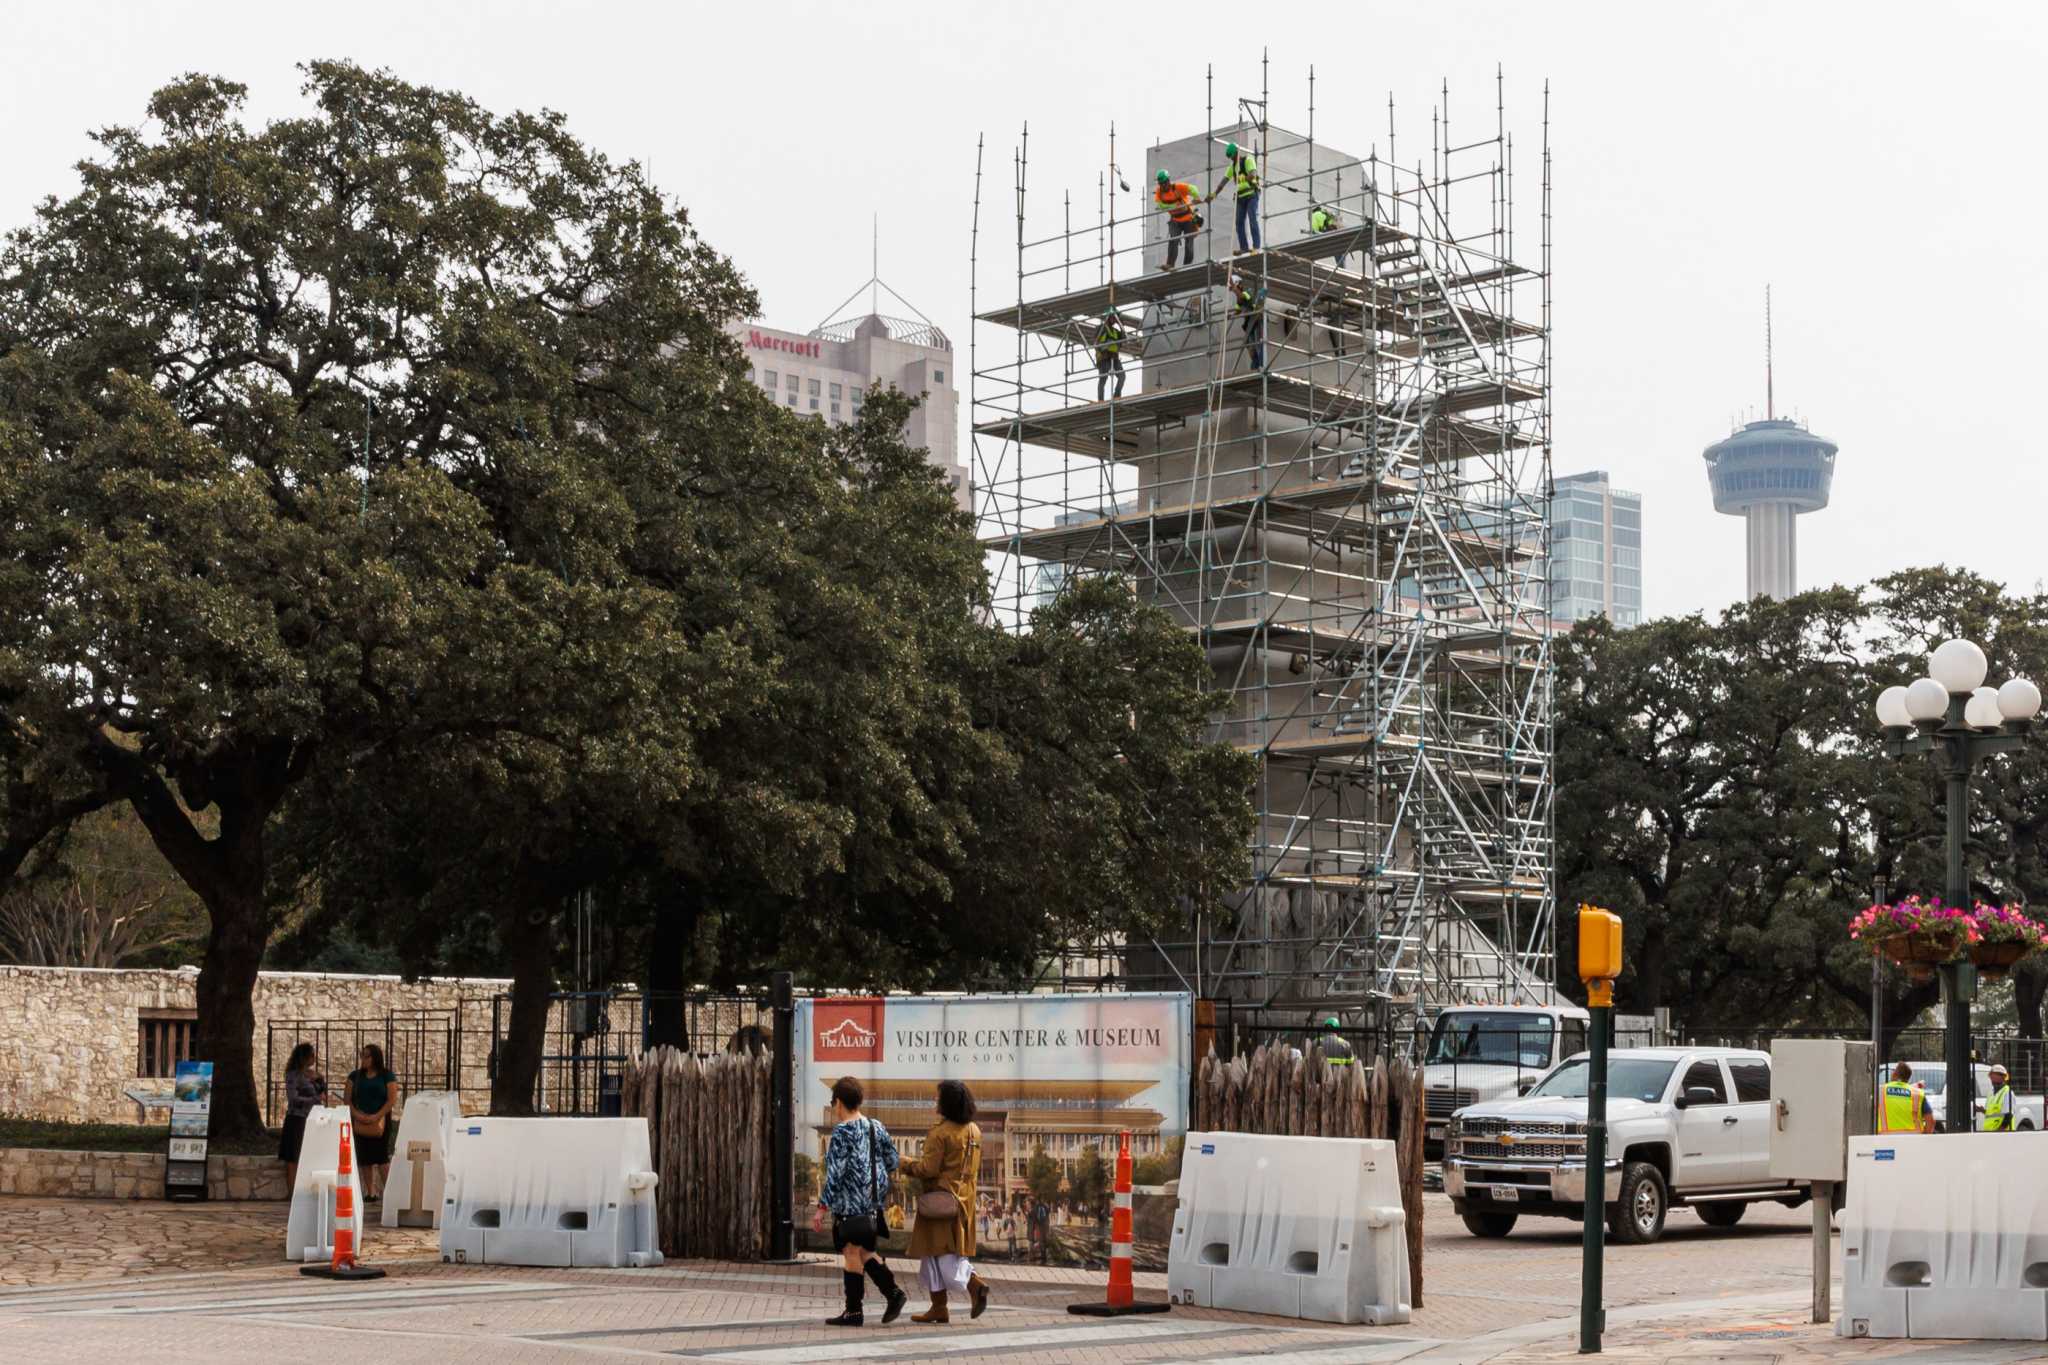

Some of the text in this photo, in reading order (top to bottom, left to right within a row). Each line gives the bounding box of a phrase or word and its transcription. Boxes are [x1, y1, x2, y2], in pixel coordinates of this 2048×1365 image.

[745, 330, 820, 357] Marriott
[821, 1032, 876, 1048] The ALAMO
[896, 1028, 1161, 1048] VISITOR CENTER & MUSEUM
[897, 1052, 1016, 1063] COMING SOON
